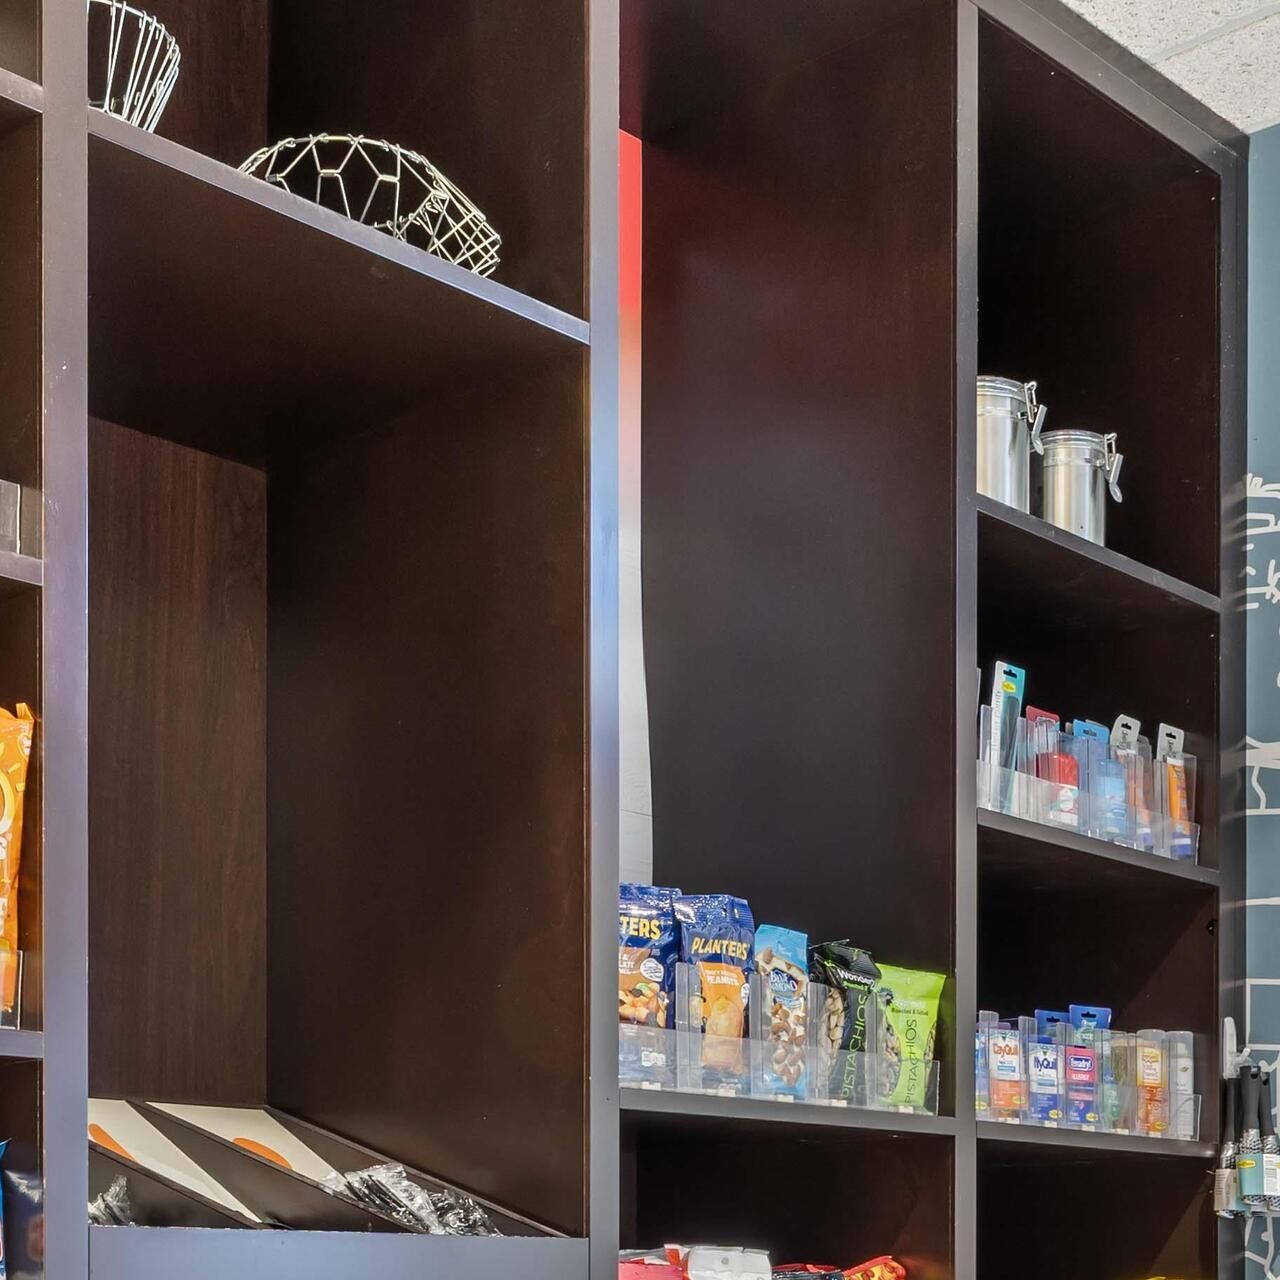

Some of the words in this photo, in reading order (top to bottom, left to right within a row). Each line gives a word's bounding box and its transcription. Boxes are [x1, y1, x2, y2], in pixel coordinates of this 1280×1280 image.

[619, 917, 661, 940] TERS
[692, 937, 748, 960] PLANTERS
[841, 995, 867, 1097] PISTACHIOS
[904, 1019, 918, 1103] PISTACHIOS
